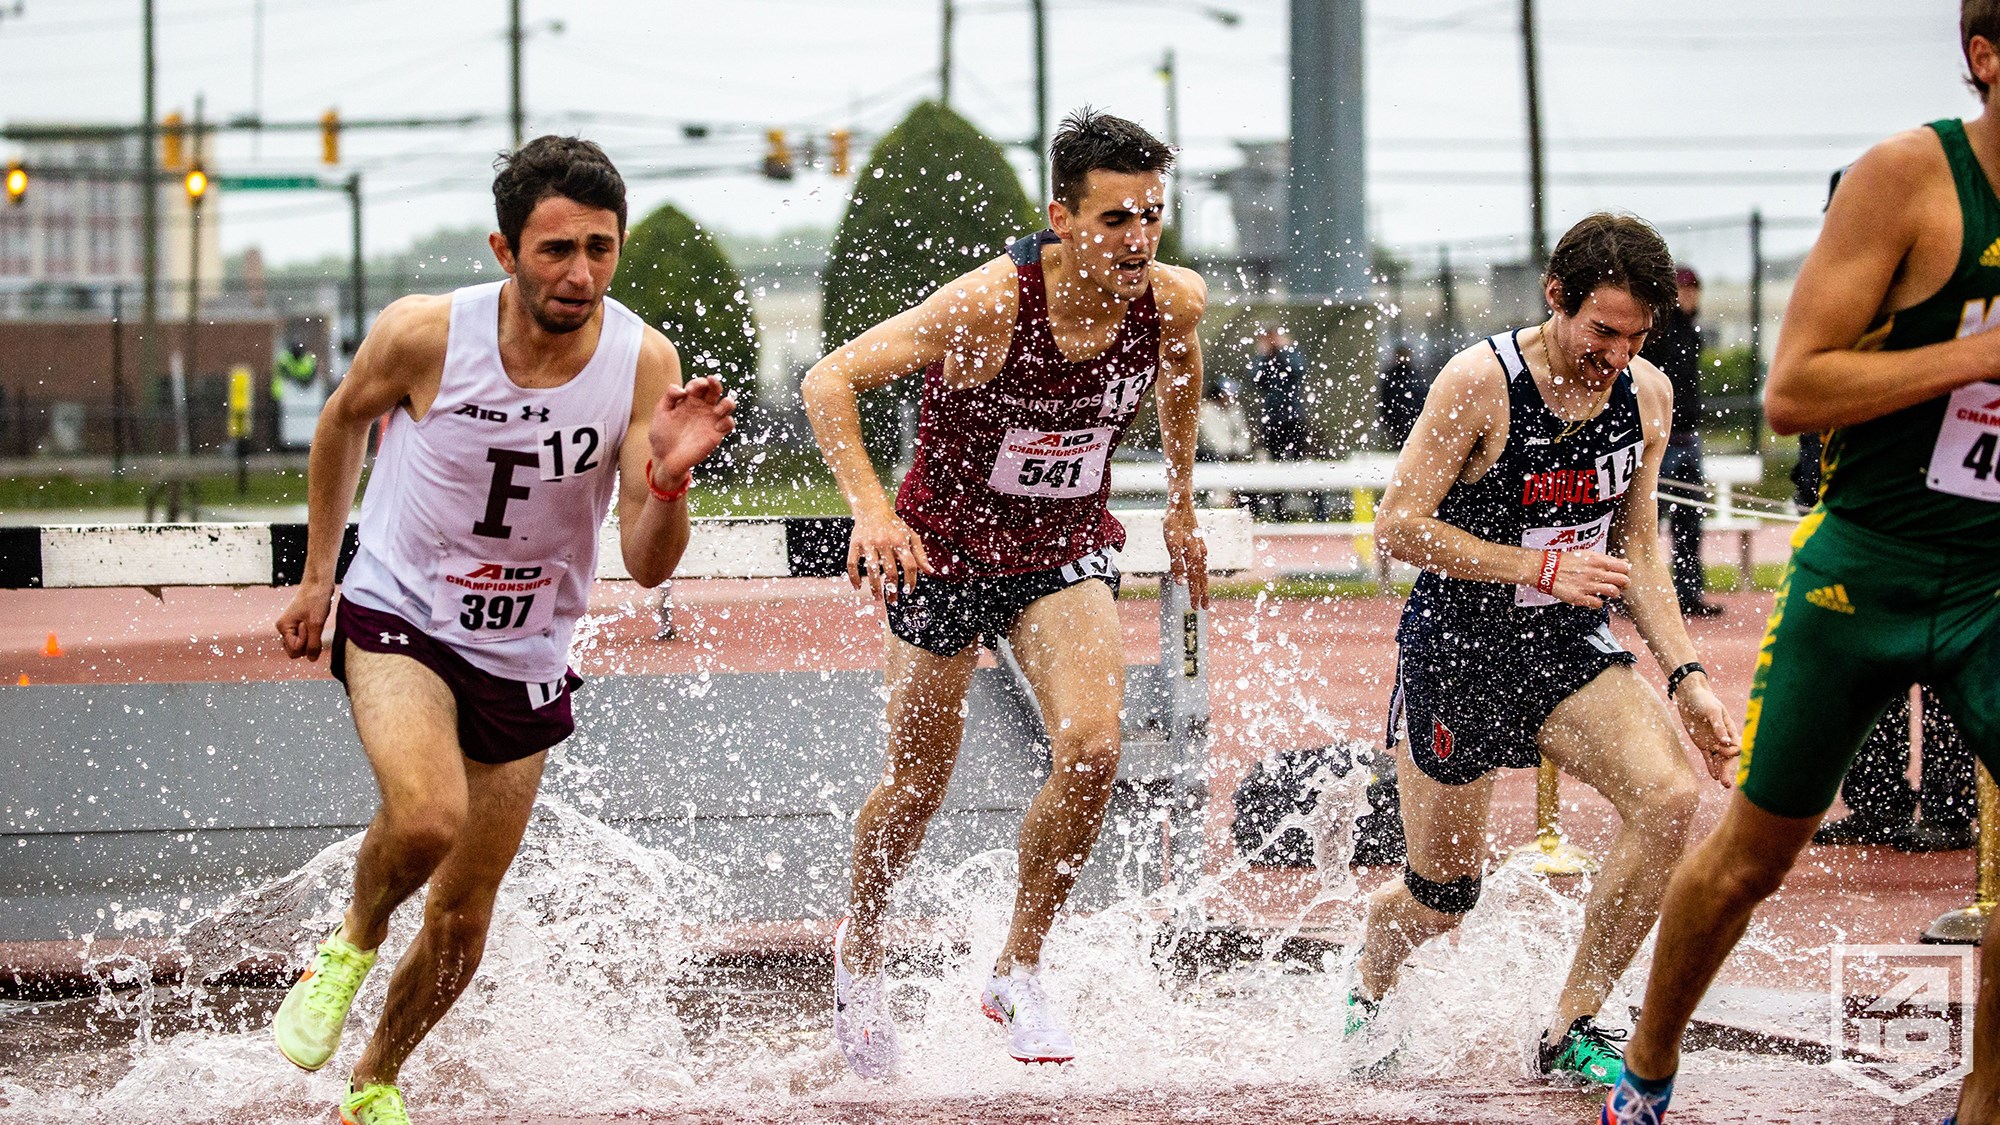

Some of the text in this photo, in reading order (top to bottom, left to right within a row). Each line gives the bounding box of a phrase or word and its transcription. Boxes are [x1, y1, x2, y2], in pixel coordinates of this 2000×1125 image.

[454, 403, 508, 423] A10
[1002, 394, 1104, 413] SAINT JOS
[544, 427, 599, 477] 12
[1008, 442, 1101, 457] CHAMPIONSHIPS
[1028, 433, 1094, 447] A10
[1962, 431, 2000, 482] 4
[1018, 457, 1084, 488] 541
[1600, 446, 1637, 496] 14
[472, 447, 552, 539] F
[1522, 469, 1600, 506] DUQUE
[1545, 523, 1601, 546] A10
[446, 576, 552, 592] CHAMPIONSHIPS
[465, 563, 542, 580] A10
[460, 594, 535, 631] 397
